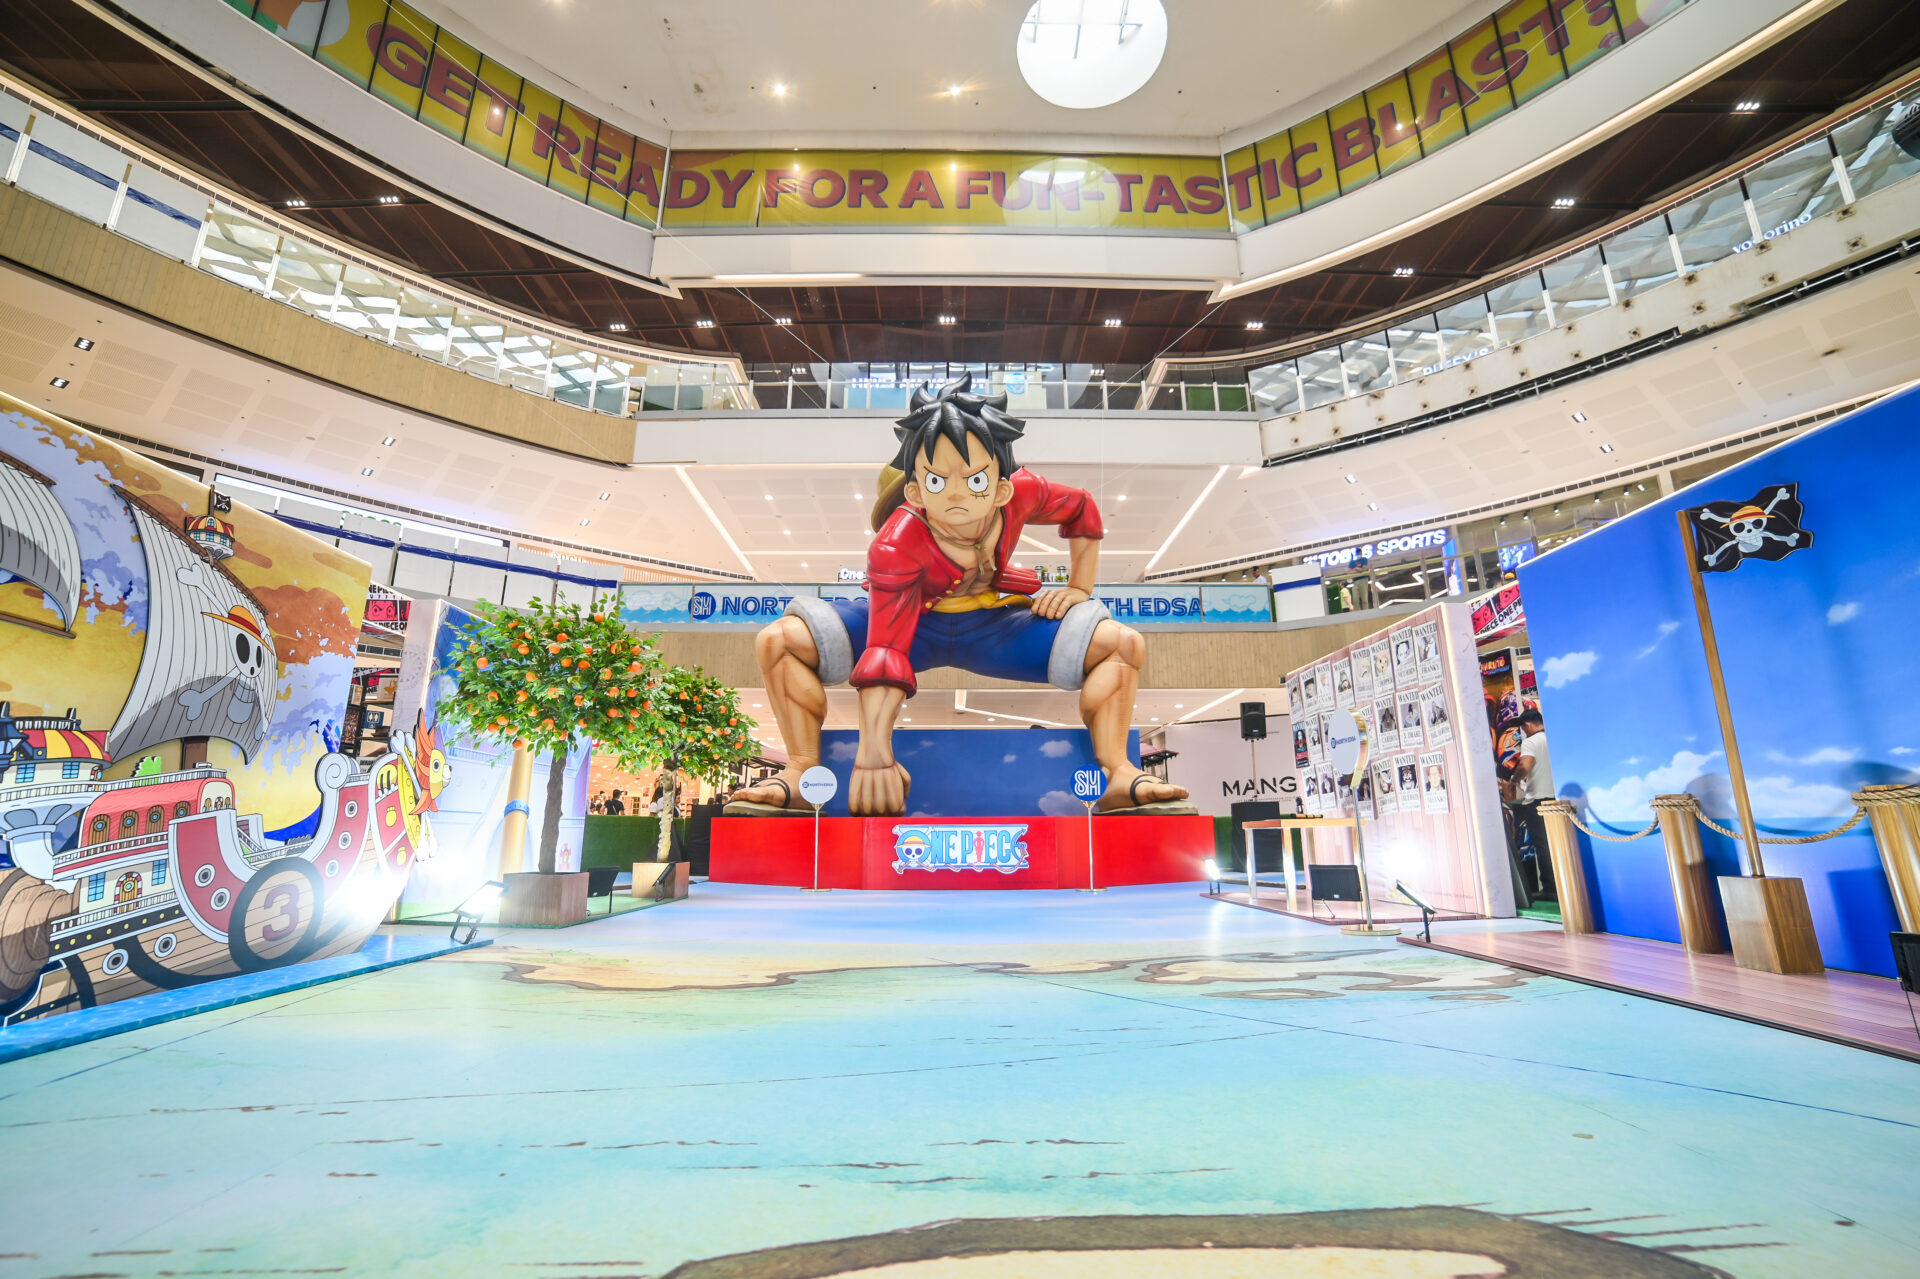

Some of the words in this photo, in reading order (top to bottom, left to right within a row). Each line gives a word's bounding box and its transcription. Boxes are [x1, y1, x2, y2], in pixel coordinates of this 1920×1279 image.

[366, 21, 525, 138] GET
[532, 112, 754, 209] READY
[761, 168, 888, 208] FOR
[898, 168, 944, 209] A
[954, 142, 1323, 214] FUN-TASTIC
[1377, 528, 1447, 556] SPORTS
[721, 596, 796, 616] NORT
[1138, 597, 1206, 617] EDSA
[1391, 628, 1412, 643] WANTED
[1414, 622, 1437, 637] WANTED
[1398, 690, 1419, 701] WANTED
[1421, 685, 1443, 702] WANTED
[1394, 754, 1416, 765] WANTED
[1420, 754, 1443, 766] WANTED
[1222, 776, 1297, 797] MANG
[896, 829, 958, 865] ONE
[960, 828, 1028, 865] PIECE
[262, 884, 299, 941] 3
